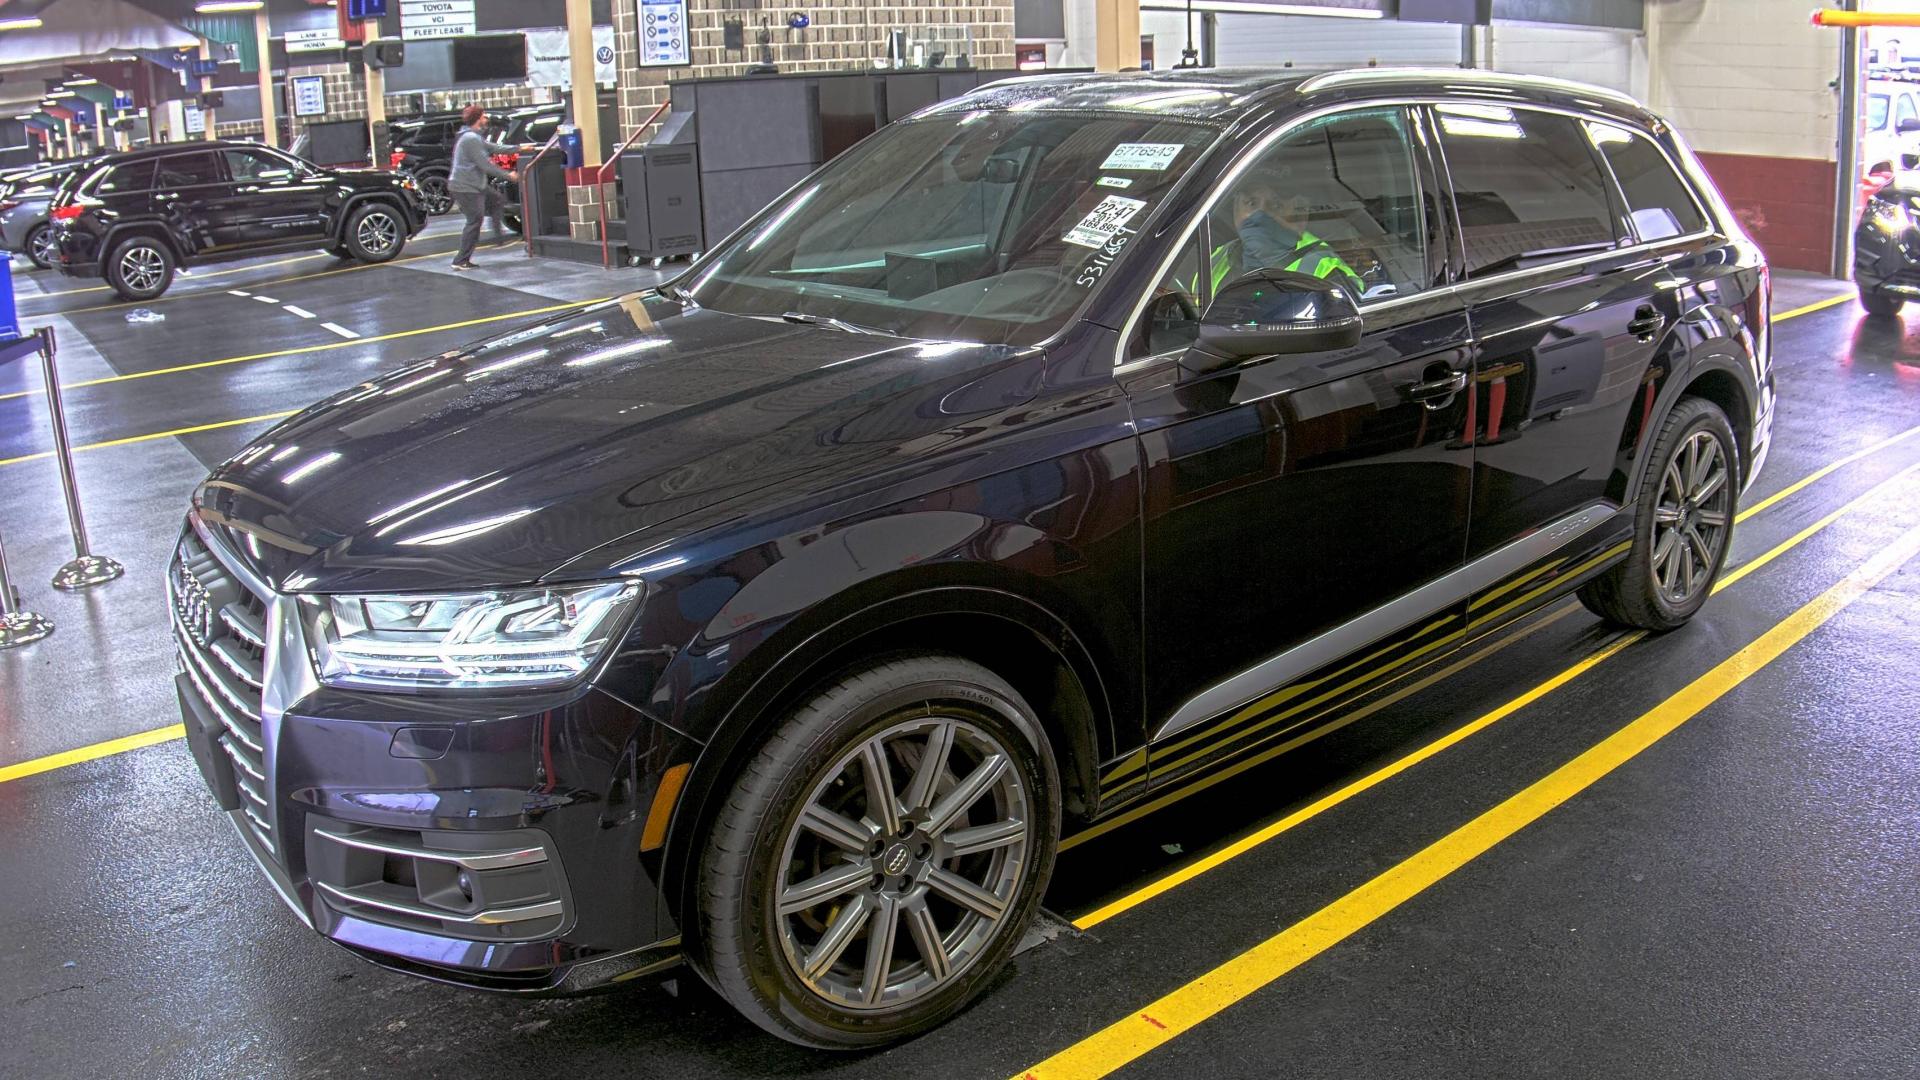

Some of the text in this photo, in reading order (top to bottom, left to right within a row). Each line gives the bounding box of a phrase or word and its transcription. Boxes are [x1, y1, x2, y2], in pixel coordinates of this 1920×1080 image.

[423, 4, 453, 12] TOYOTA
[413, 26, 465, 36] FLEET LEASE
[1114, 146, 1176, 157] 6776543
[1093, 202, 1137, 219] 22:47
